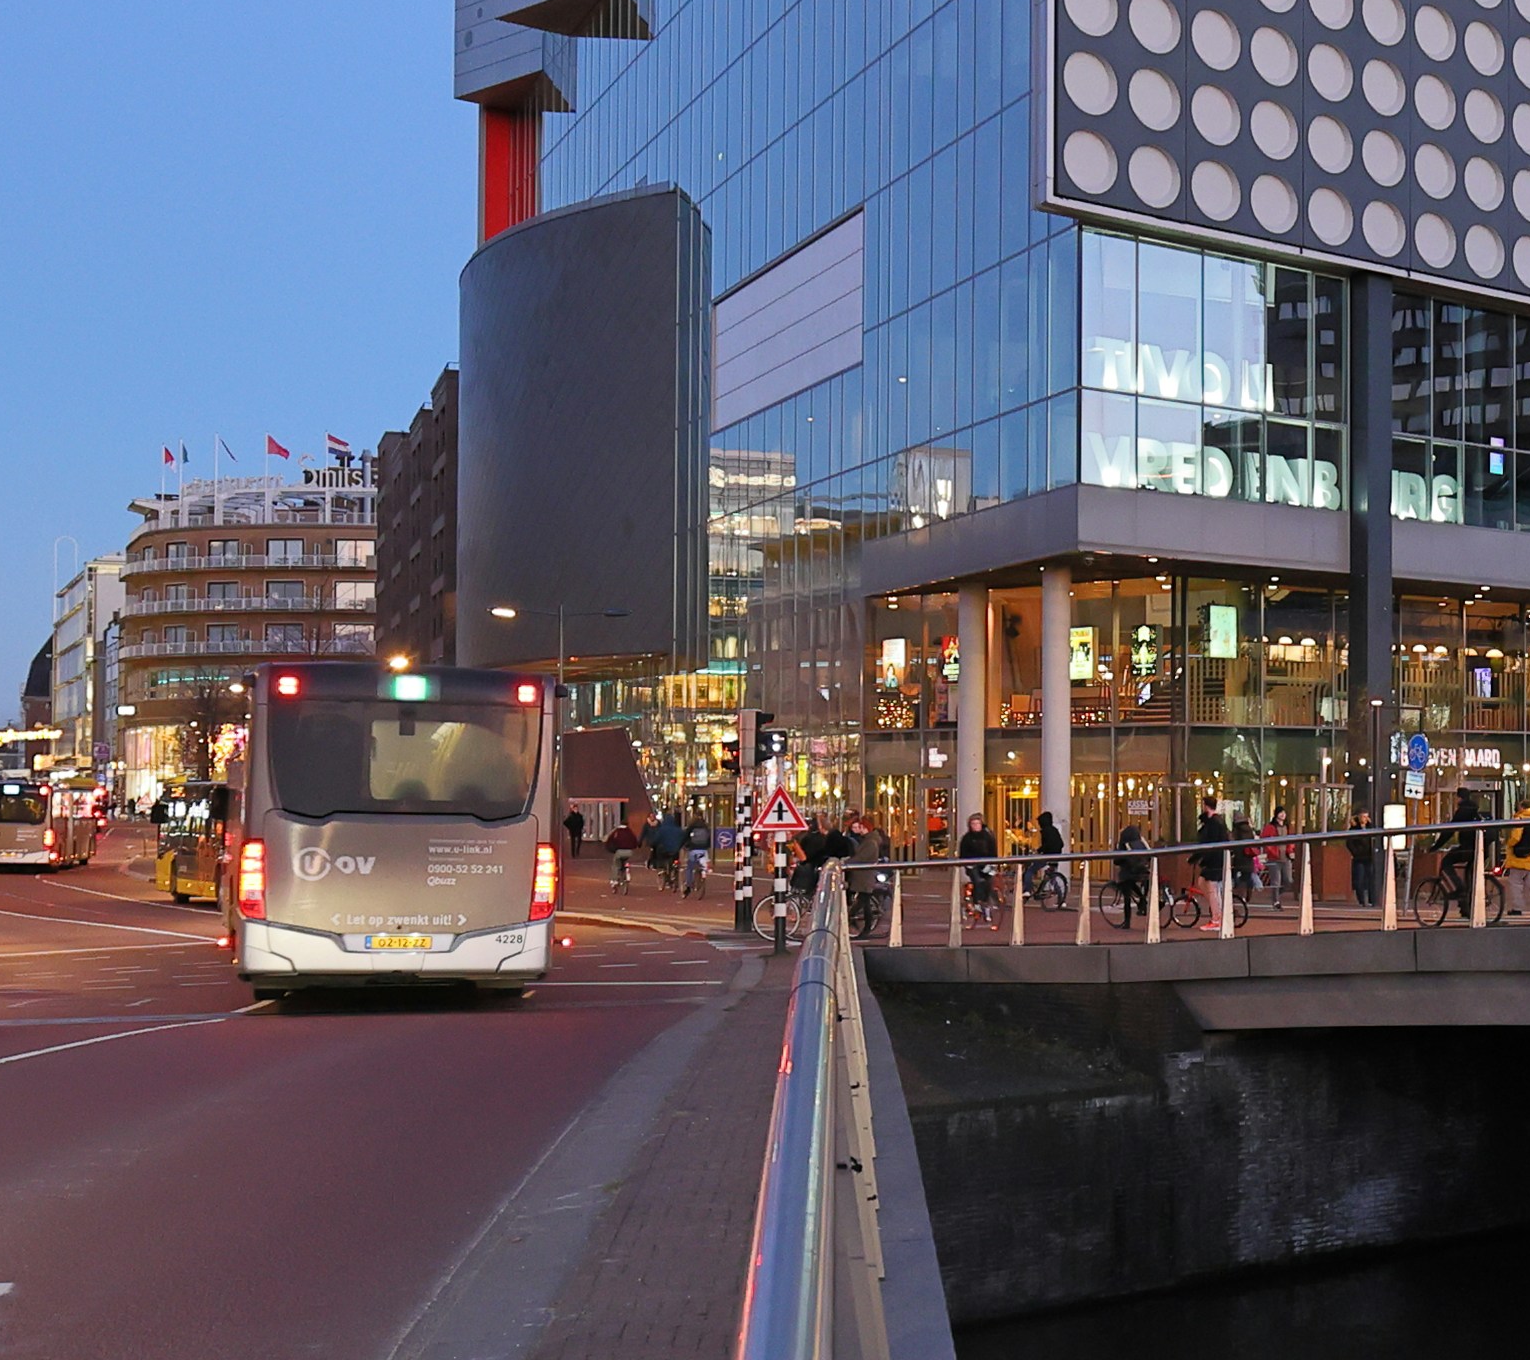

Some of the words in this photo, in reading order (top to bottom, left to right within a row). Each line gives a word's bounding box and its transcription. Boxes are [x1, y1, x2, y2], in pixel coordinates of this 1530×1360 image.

[1088, 337, 1275, 413] TIVOLI
[1087, 431, 1464, 524] VREDENBRG
[429, 845, 492, 854] www.u-link.nl
[427, 864, 468, 873] 0900-52
[471, 865, 483, 873] 52
[486, 865, 504, 874] 241
[427, 876, 456, 886] Qbuzz
[347, 914, 366, 924] Let
[369, 916, 383, 926] op
[386, 914, 428, 925] zwenkt
[432, 914, 452, 924] uit!
[495, 935, 523, 944] 4228
